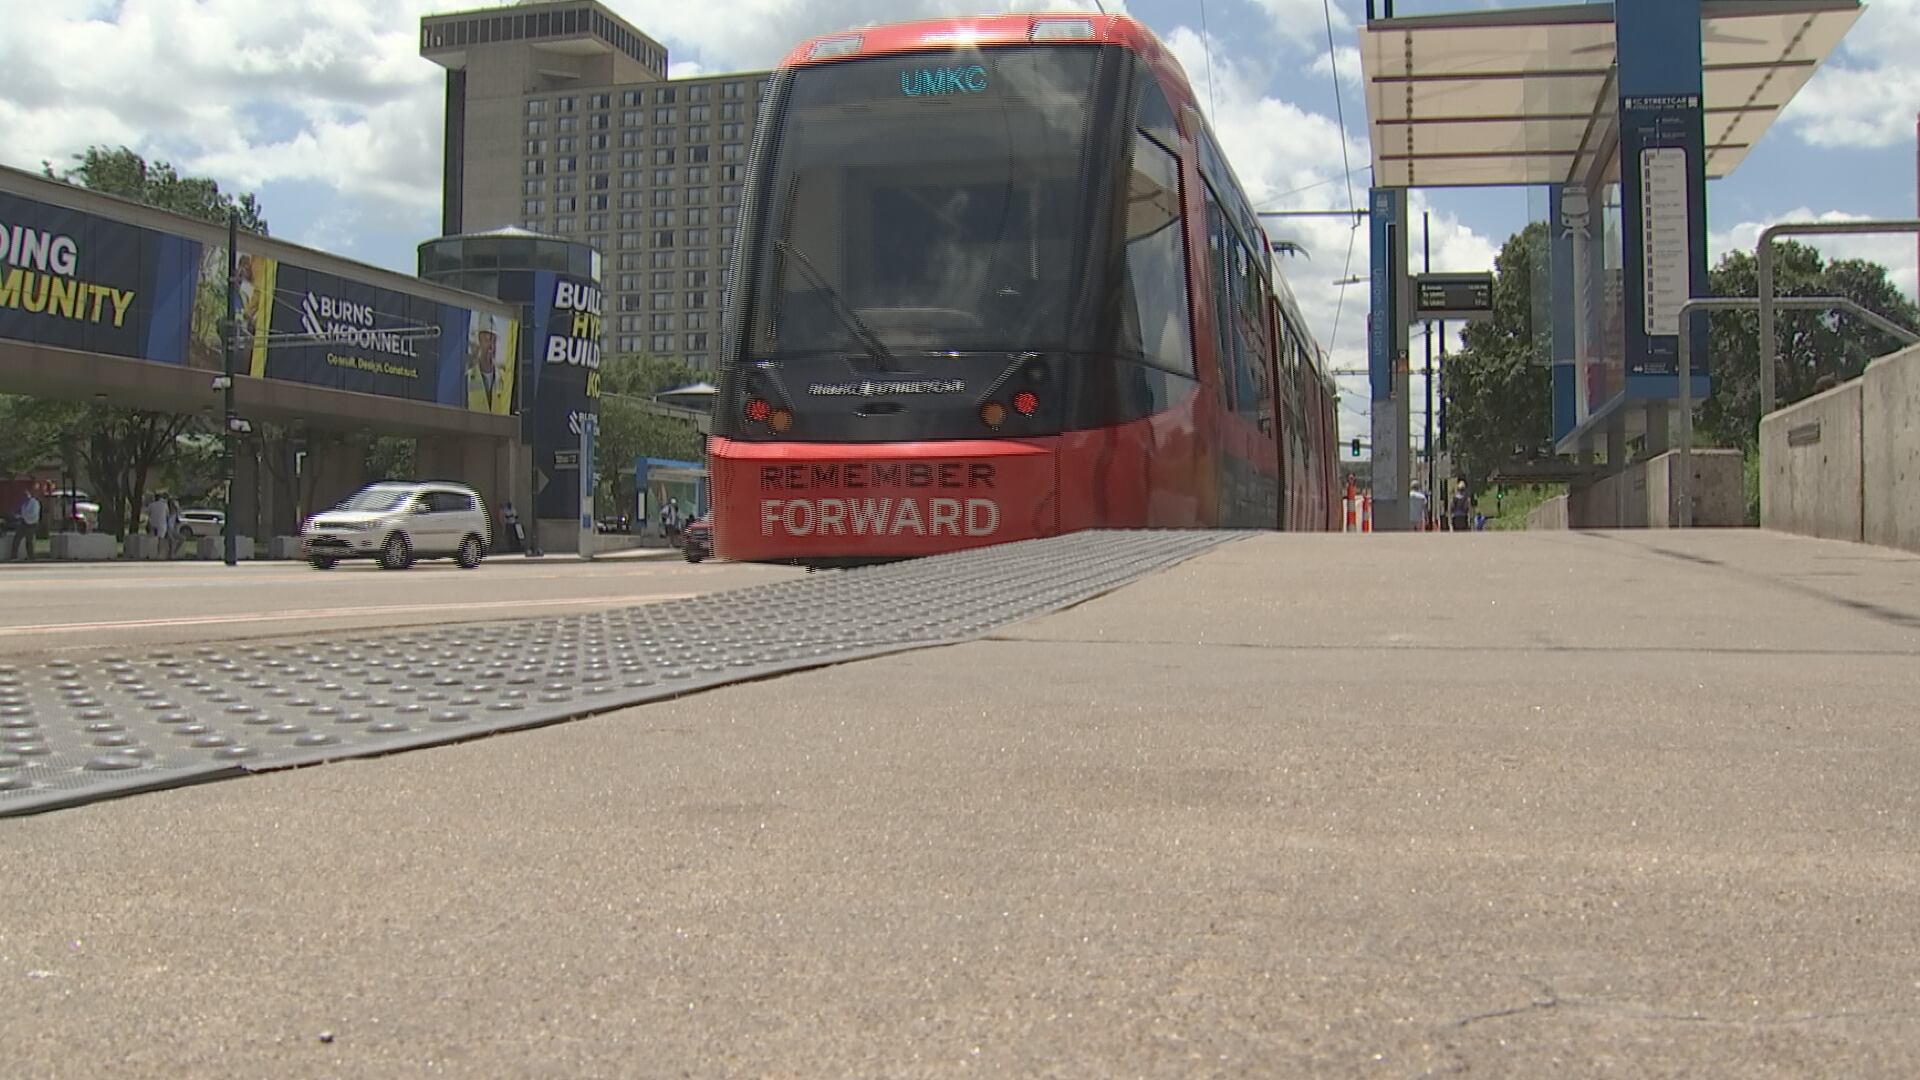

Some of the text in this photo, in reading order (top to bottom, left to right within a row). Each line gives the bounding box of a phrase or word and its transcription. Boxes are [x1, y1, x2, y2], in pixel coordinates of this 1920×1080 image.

[901, 66, 987, 96] UMKC
[321, 297, 373, 326] BURNS
[873, 380, 966, 395] STREETCAR
[760, 463, 996, 490] REMEMBER
[761, 498, 1001, 536] FORWARD
